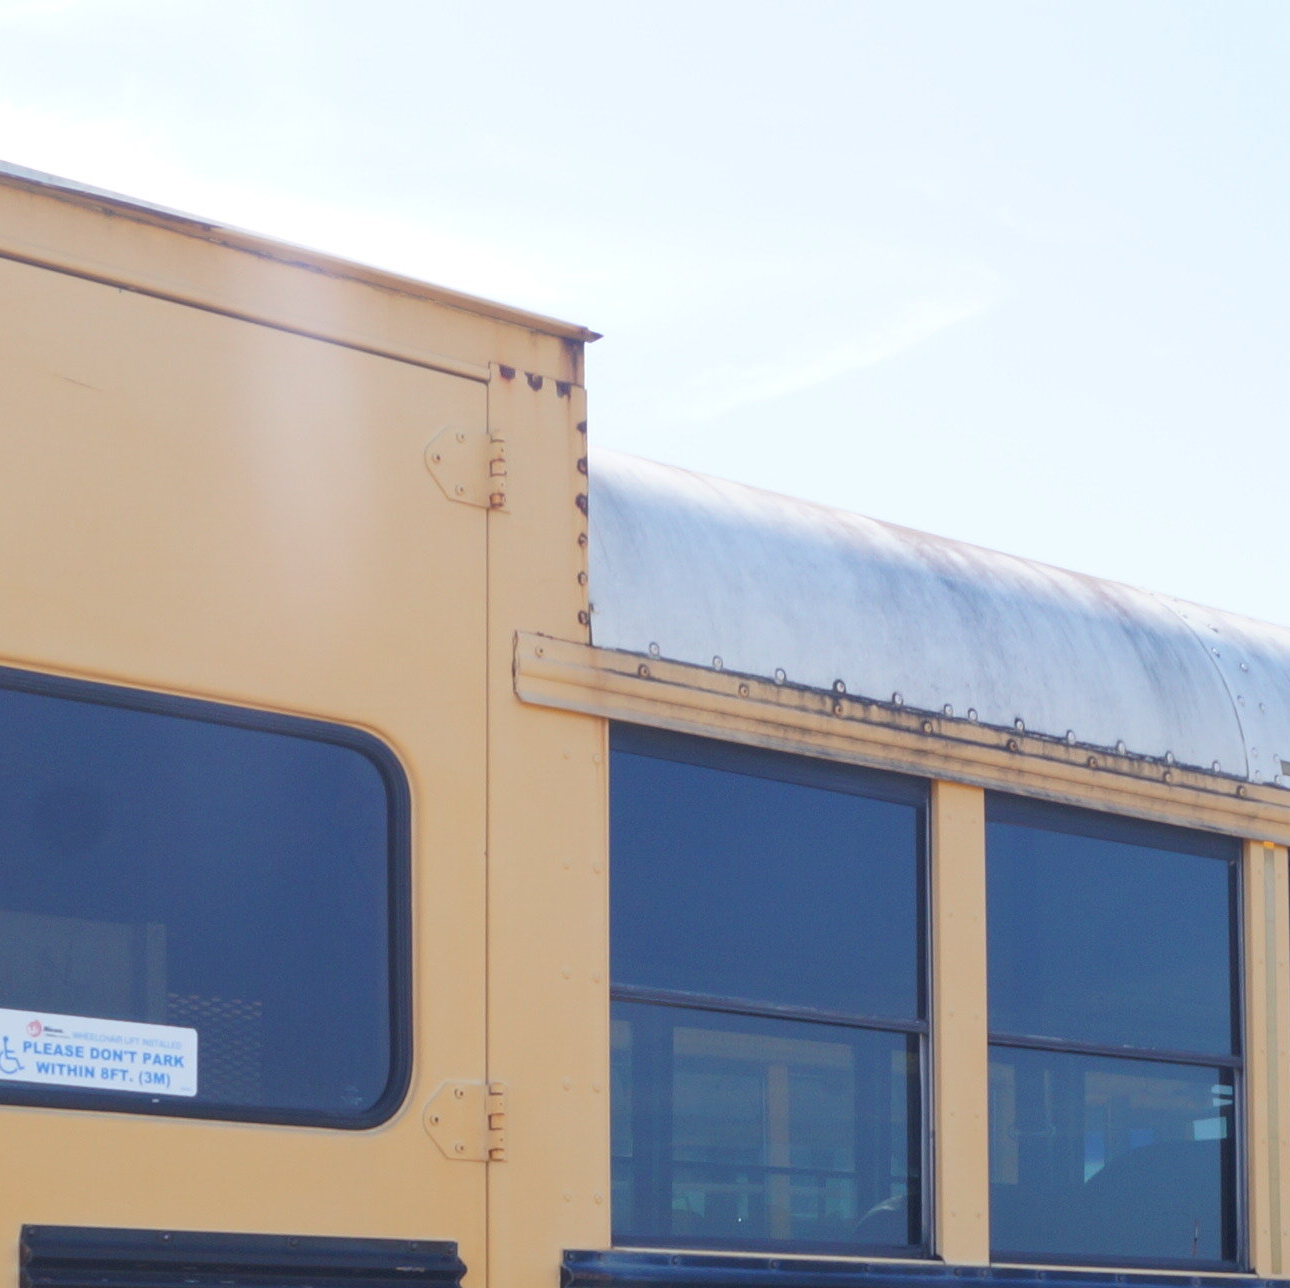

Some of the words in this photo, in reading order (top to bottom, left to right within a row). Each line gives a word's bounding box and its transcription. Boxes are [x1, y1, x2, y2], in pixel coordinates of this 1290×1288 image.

[23, 1041, 84, 1059] PLEASE
[90, 1047, 138, 1063] DON'T
[142, 1052, 185, 1068] PARK
[36, 1061, 95, 1079] WITHIN
[100, 1065, 134, 1082] 8FT.
[139, 1071, 171, 1088] (3M)
